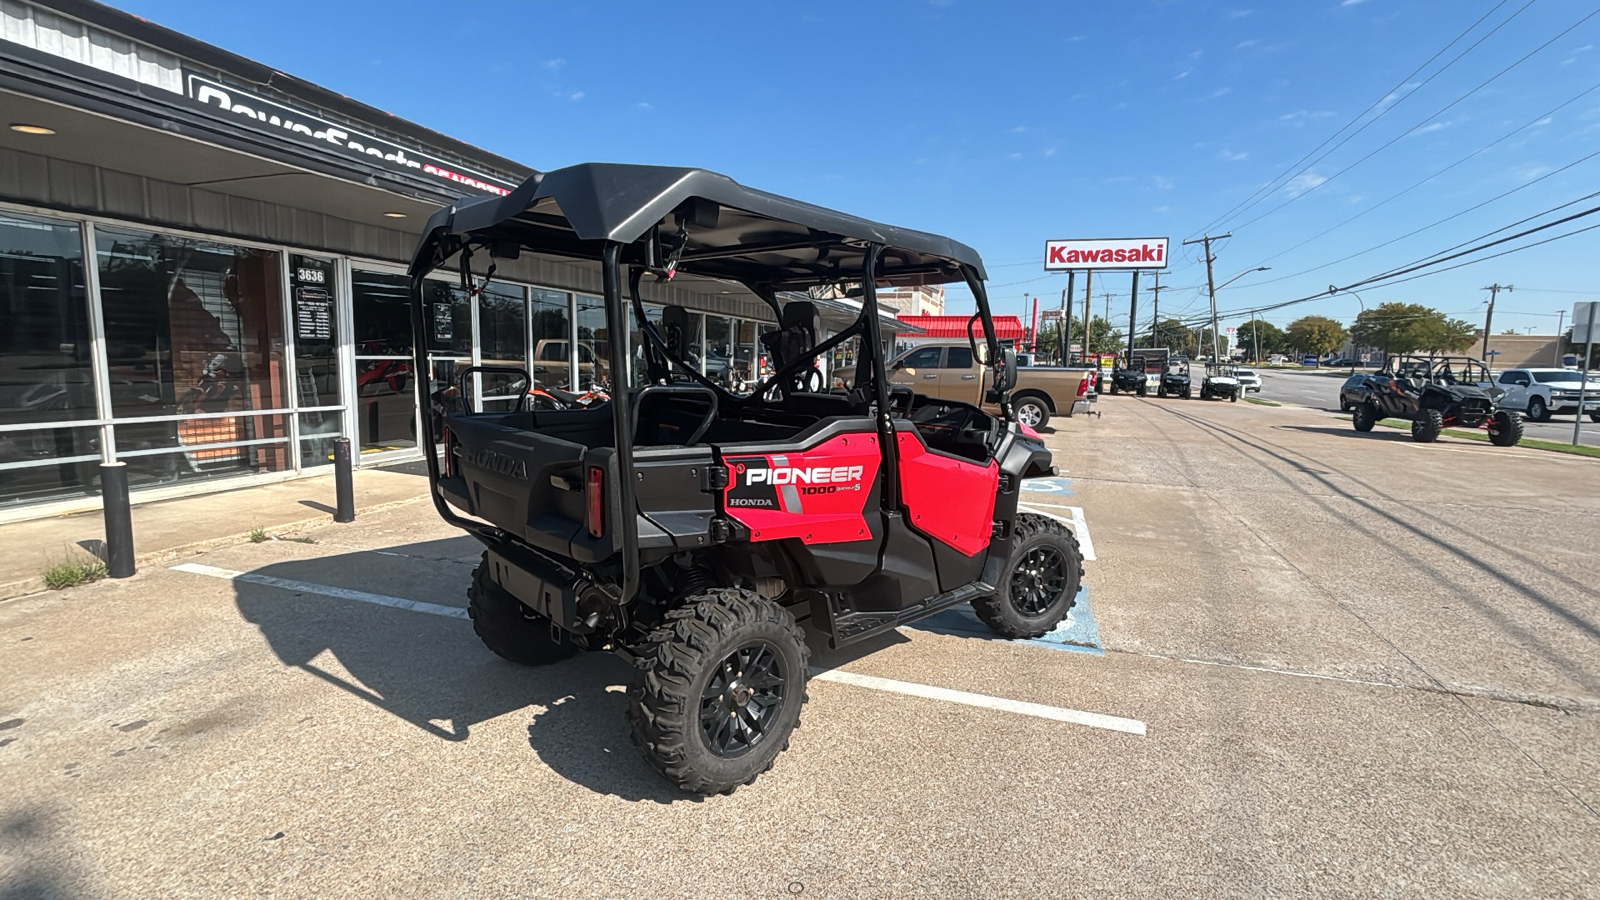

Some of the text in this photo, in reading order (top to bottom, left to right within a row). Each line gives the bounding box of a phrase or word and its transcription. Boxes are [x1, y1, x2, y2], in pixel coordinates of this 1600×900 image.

[1049, 244, 1164, 264] Kawasaki
[299, 269, 324, 282] 3636
[465, 447, 529, 481] HONDA
[746, 465, 863, 486] PIONEER
[801, 485, 836, 495] 1000
[729, 498, 773, 507] HONDA
